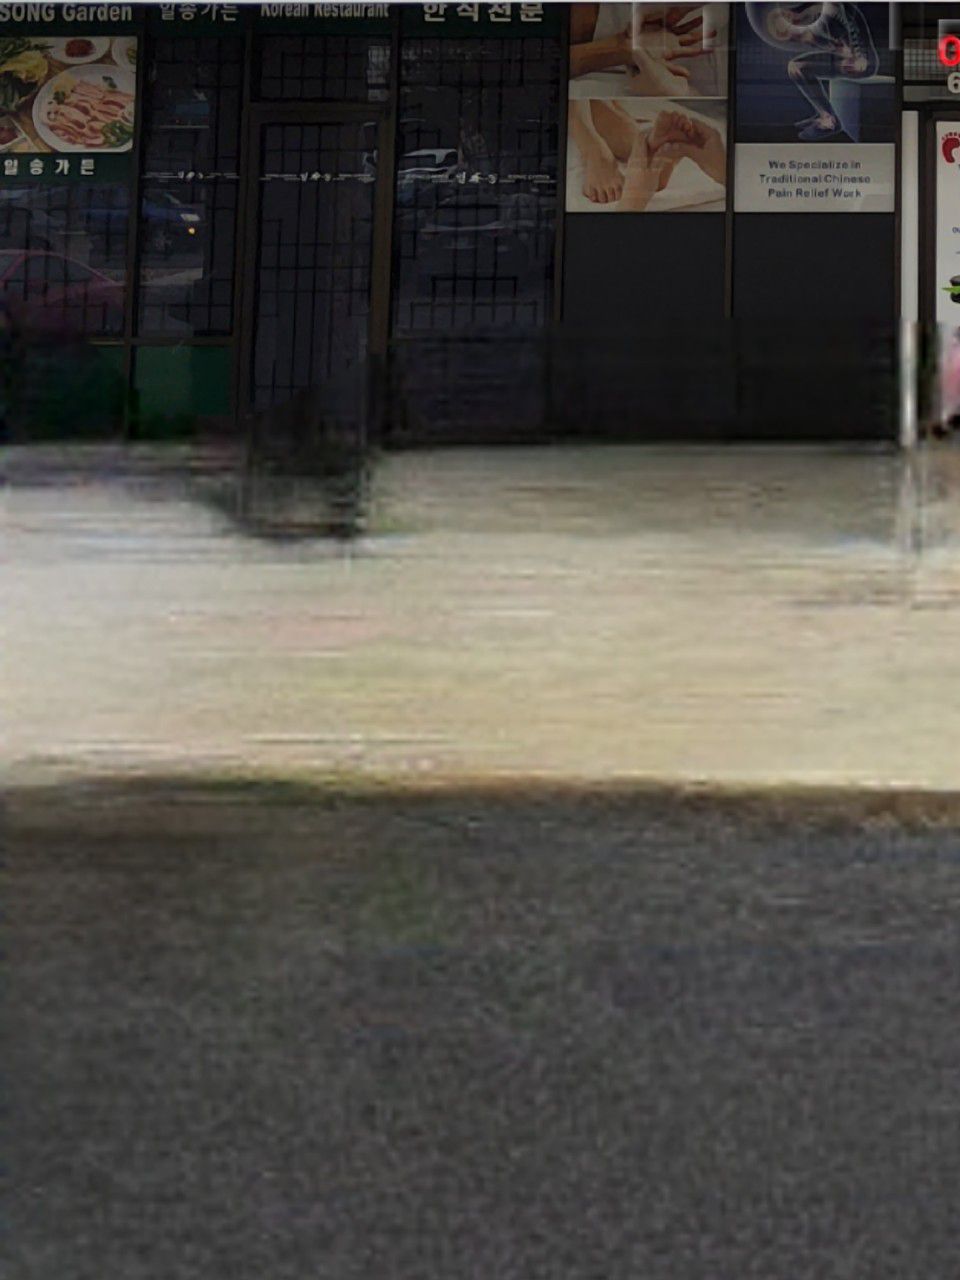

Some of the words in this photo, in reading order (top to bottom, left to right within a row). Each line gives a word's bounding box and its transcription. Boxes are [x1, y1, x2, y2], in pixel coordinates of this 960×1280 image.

[0, 2, 55, 23] SONG
[62, 2, 133, 23] Garden
[260, 2, 309, 18] Korean
[314, 2, 389, 18] Restaurant
[768, 160, 786, 169] We
[788, 160, 848, 171] Specialize
[850, 160, 861, 169] in
[759, 174, 822, 184] Traditional
[823, 174, 871, 184] Chinese
[768, 188, 793, 198] Pain
[795, 188, 829, 198] Relief
[832, 188, 862, 198] Work
